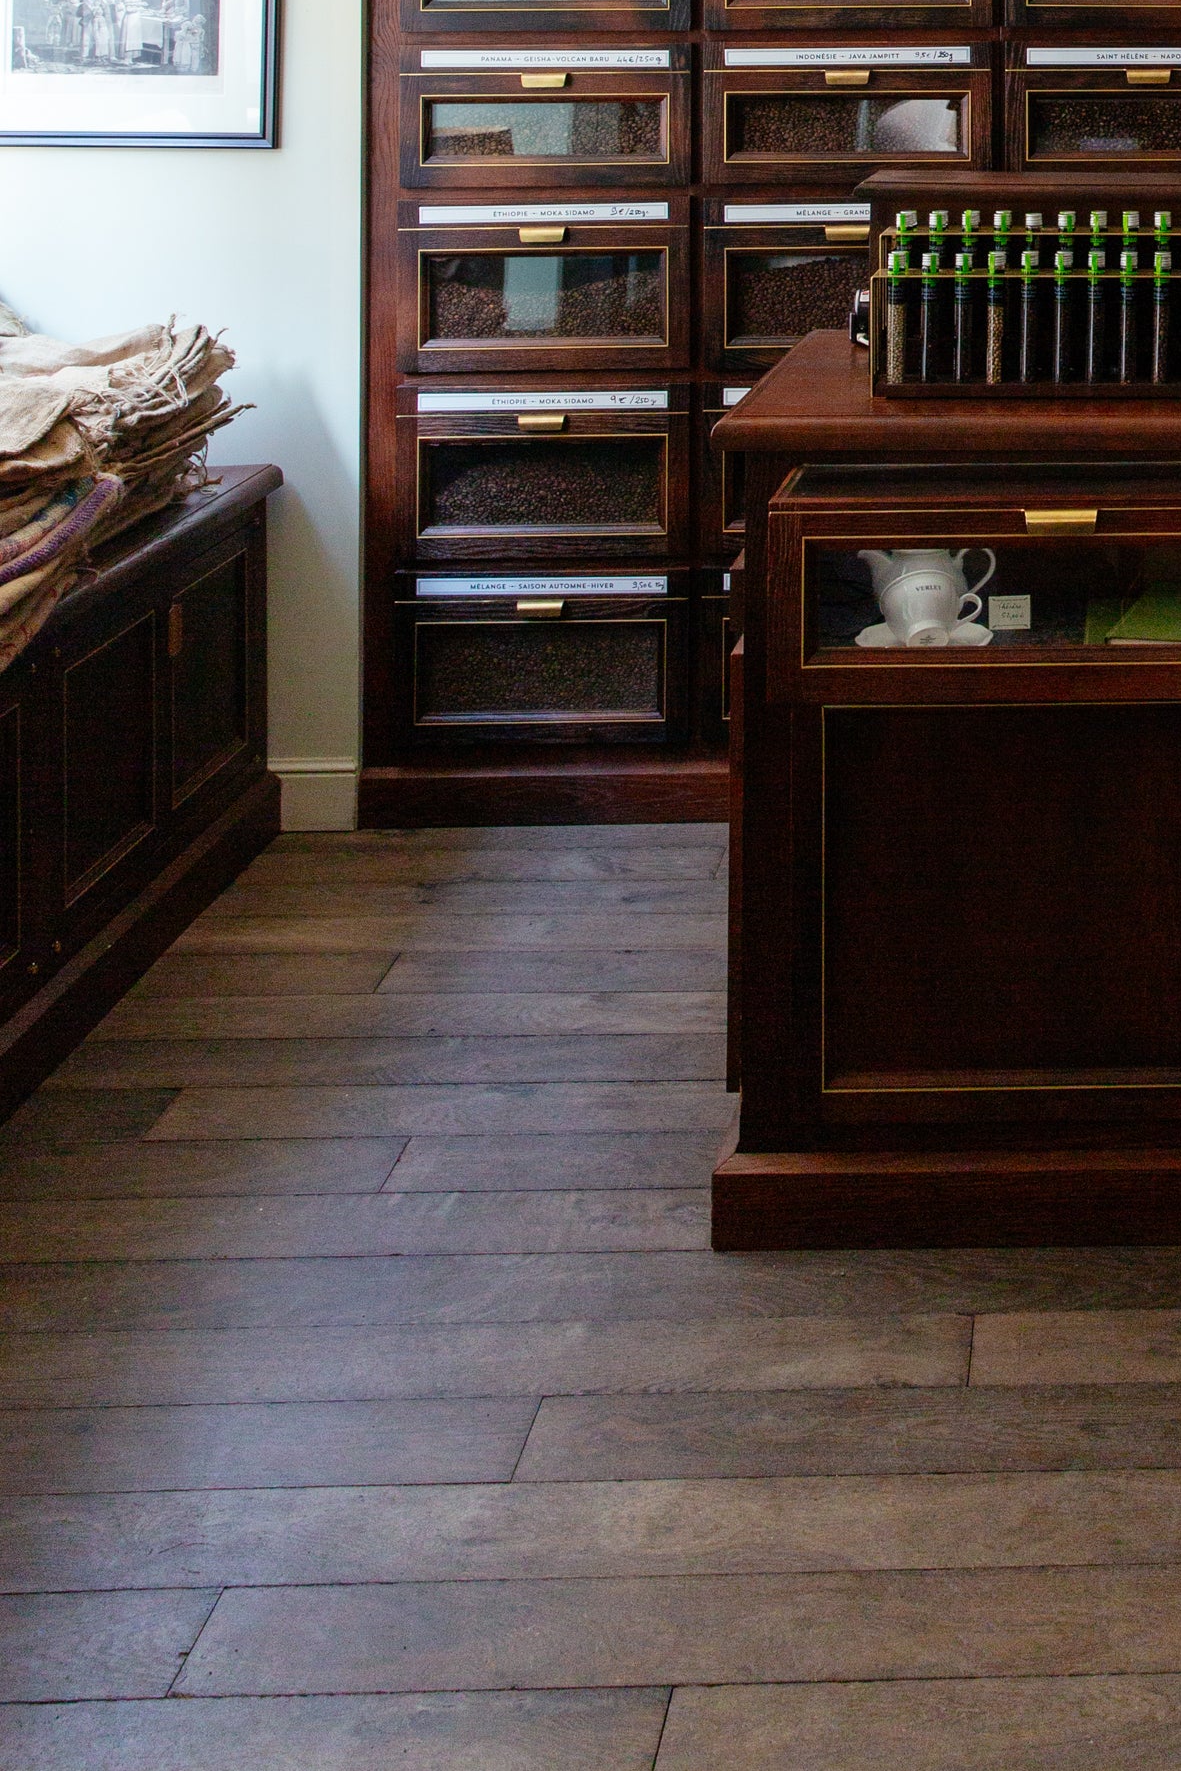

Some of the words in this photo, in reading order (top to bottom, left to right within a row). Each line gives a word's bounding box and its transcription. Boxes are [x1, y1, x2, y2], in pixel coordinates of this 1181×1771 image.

[796, 52, 837, 60] INDONÉSIE
[493, 209, 530, 217] ÉTHIOPIE
[796, 208, 832, 216] MÉLANGE
[470, 582, 506, 590] MÉLANGE
